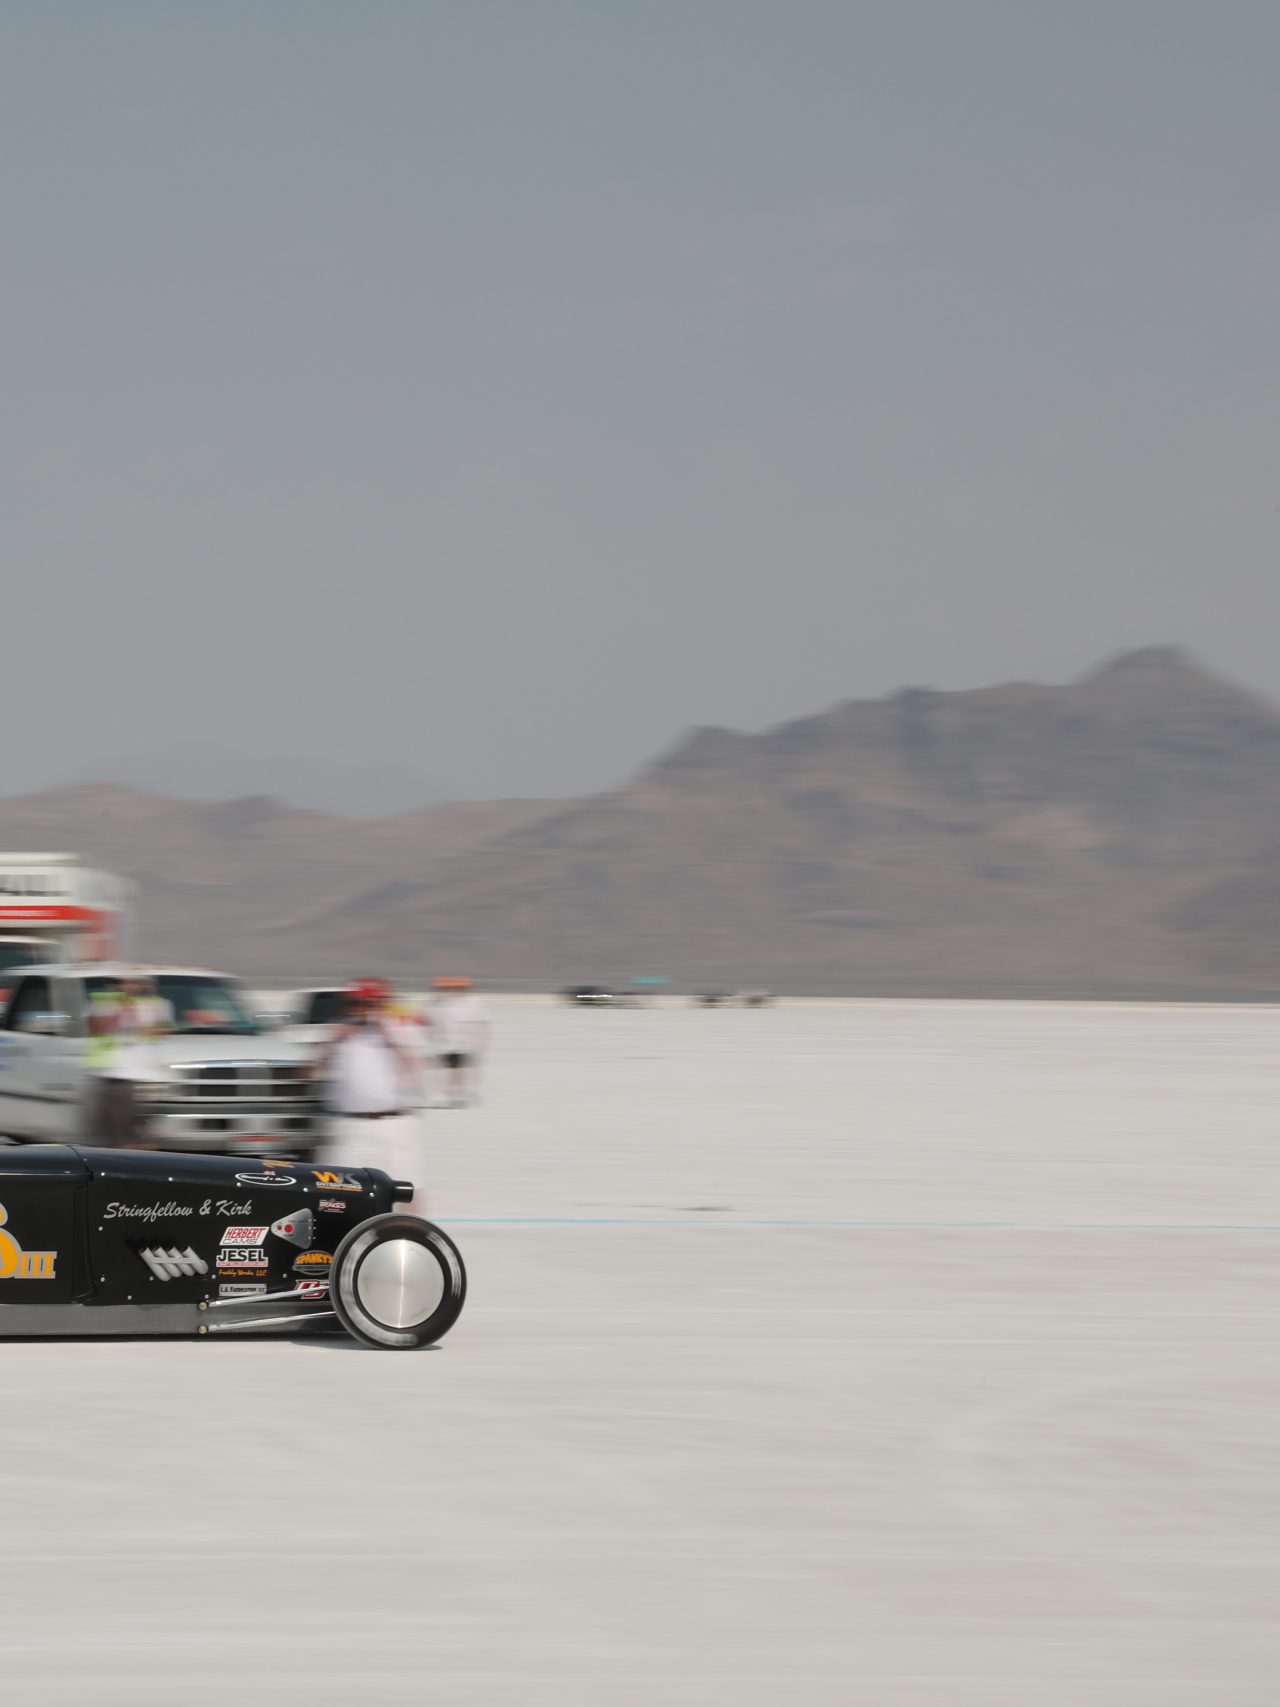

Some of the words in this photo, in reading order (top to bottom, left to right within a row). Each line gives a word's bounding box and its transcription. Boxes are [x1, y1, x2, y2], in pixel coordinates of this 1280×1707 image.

[103, 1201, 194, 1223] Stringfellow
[198, 1199, 212, 1216] &
[215, 1199, 253, 1217] Kirk
[225, 1228, 267, 1239] HERBERT
[218, 1249, 266, 1262] JESEL
